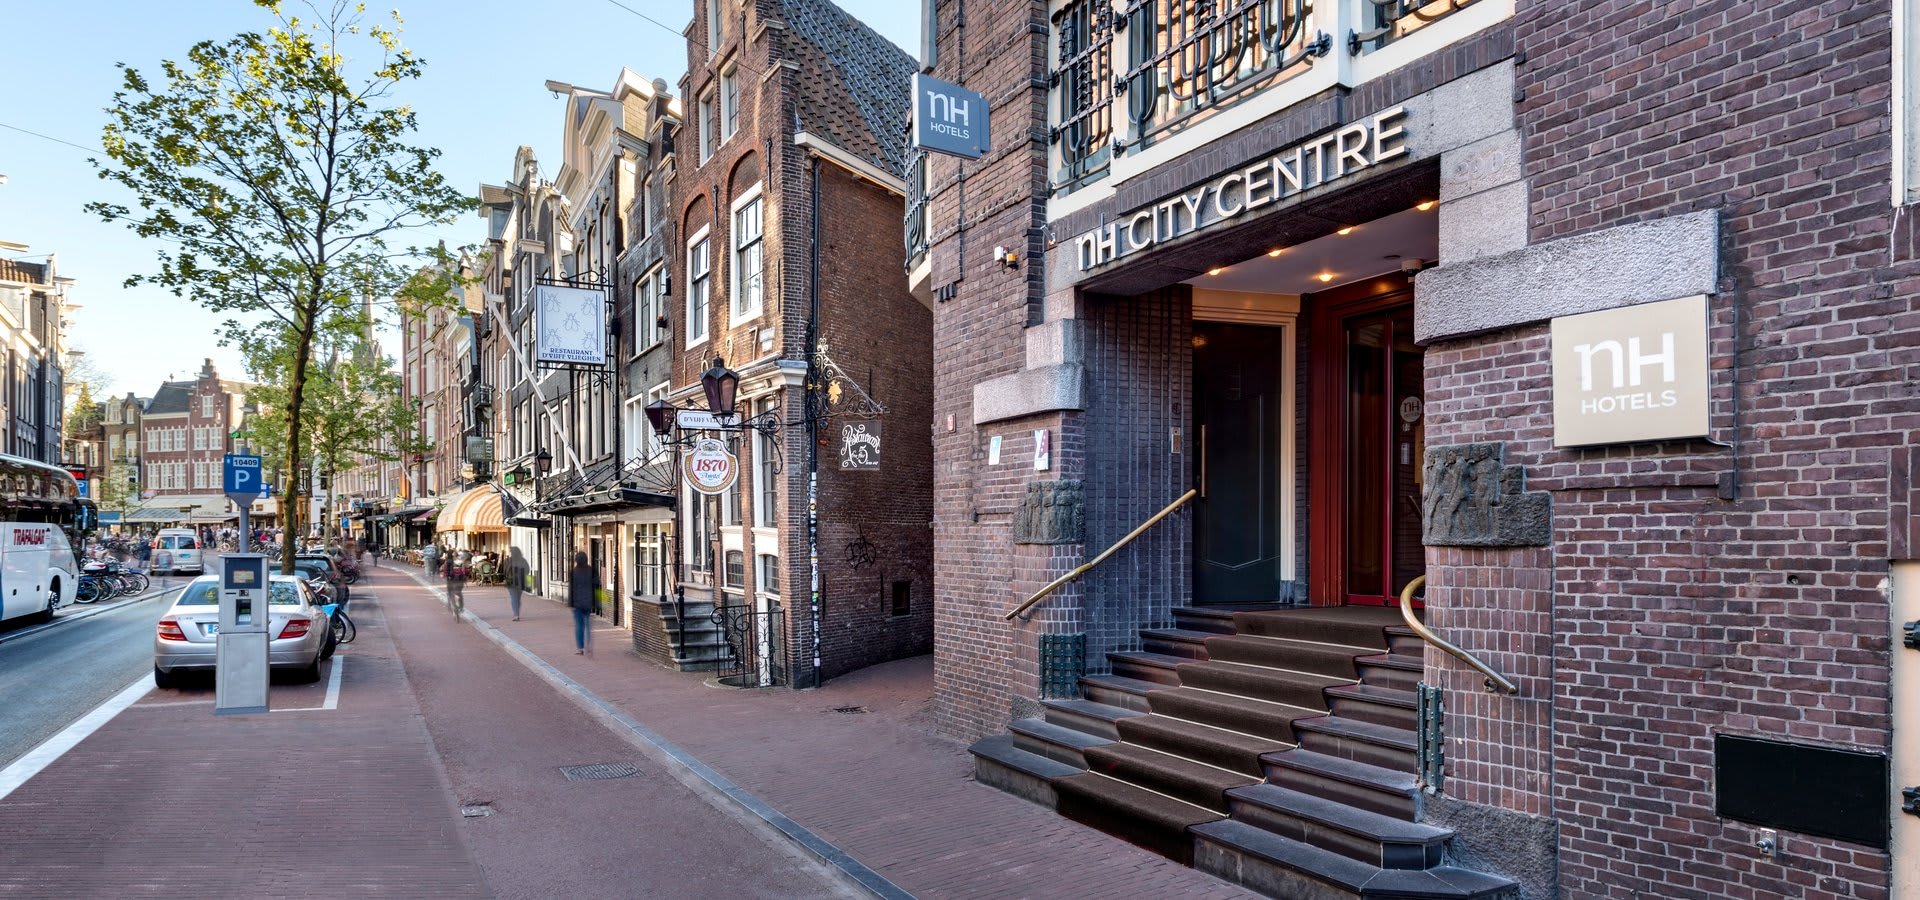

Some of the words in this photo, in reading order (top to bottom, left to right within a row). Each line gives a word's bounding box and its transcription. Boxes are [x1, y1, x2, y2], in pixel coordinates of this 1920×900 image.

[930, 121, 970, 139] HOTELS
[1128, 186, 1208, 250] CITY
[1215, 105, 1406, 218] CENTRE
[550, 347, 593, 356] RESTAURANT
[567, 354, 601, 362] VLIEGHEN
[1581, 389, 1677, 415] HOTELS
[695, 459, 727, 472] 1870
[234, 469, 251, 490] P
[13, 528, 46, 546] TRAFALGAR
